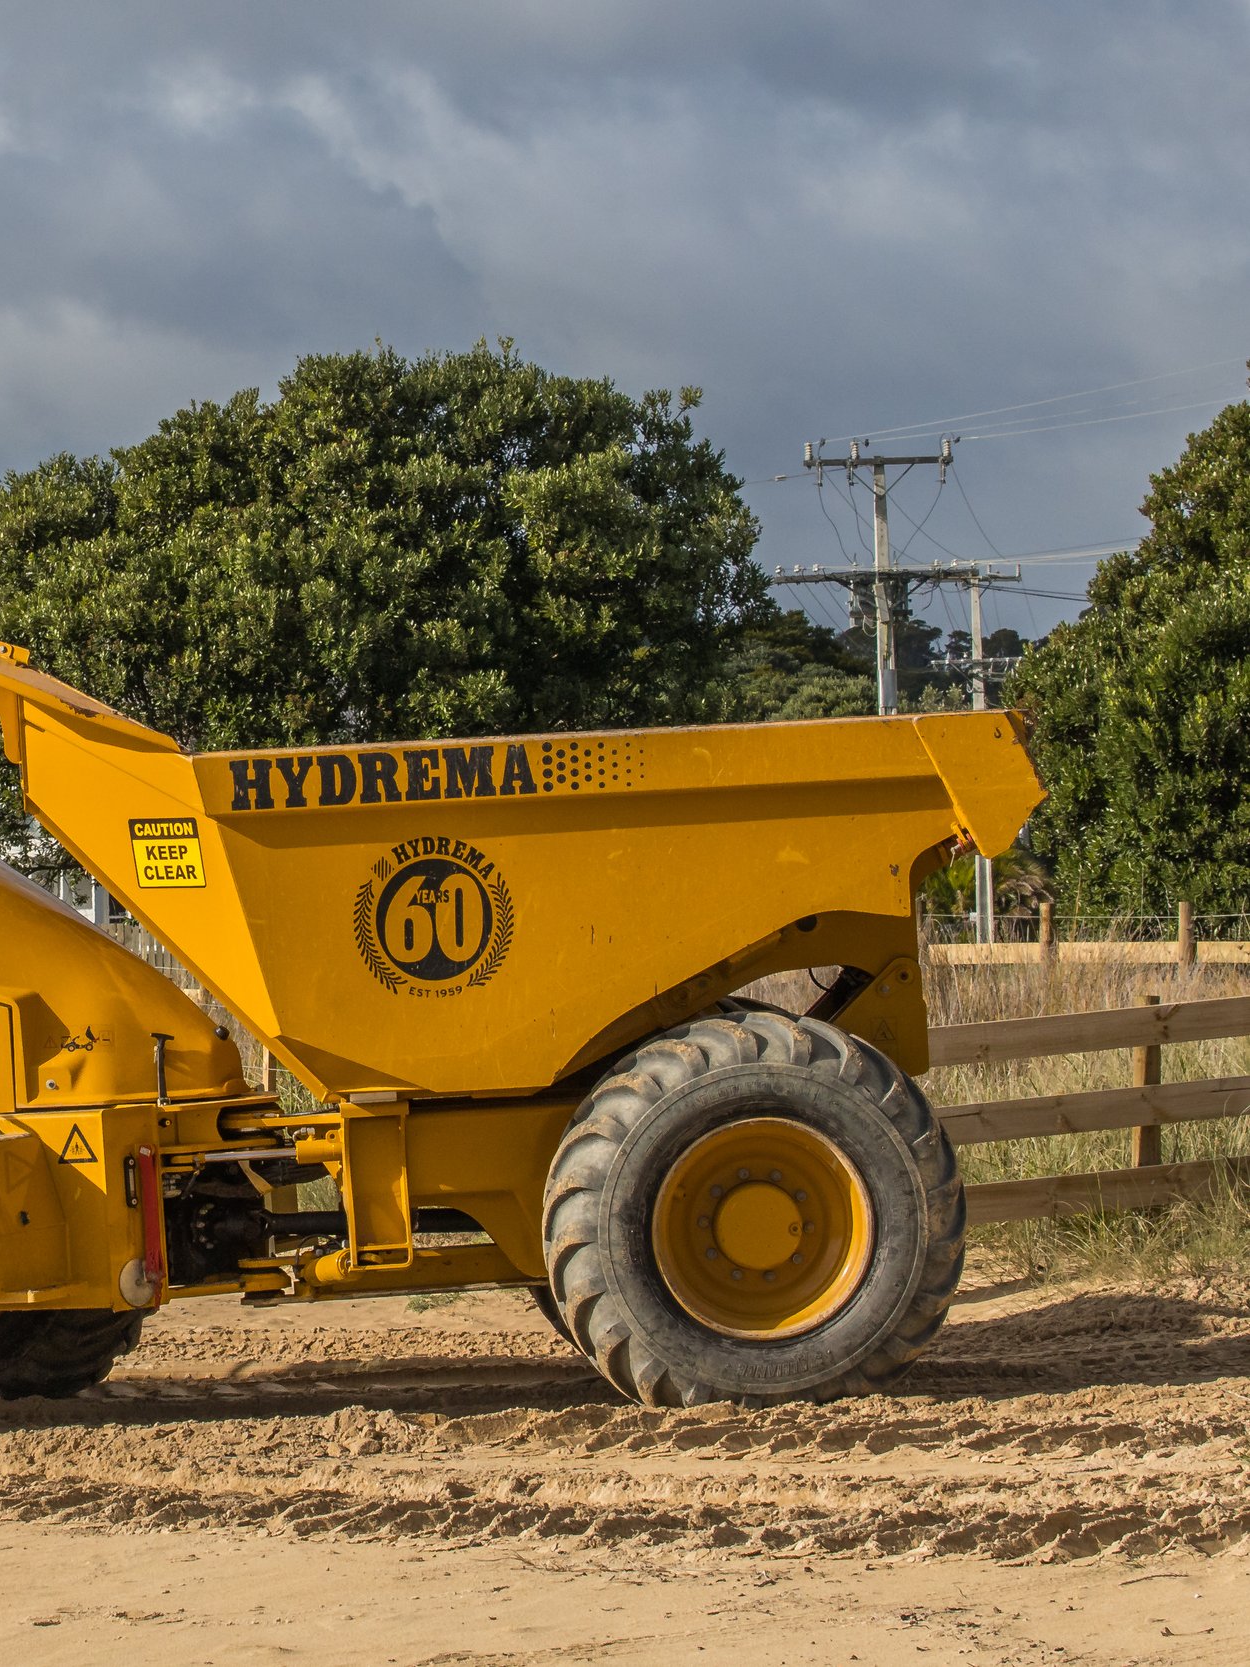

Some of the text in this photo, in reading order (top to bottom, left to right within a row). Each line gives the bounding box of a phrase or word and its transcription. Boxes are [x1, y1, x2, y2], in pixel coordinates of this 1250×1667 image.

[229, 744, 538, 811] HYDREMA
[134, 822, 194, 837] CAUTION
[145, 845, 188, 861] KEEP
[391, 836, 495, 880] HYDREMA
[143, 864, 198, 880] CLEAR
[416, 889, 450, 904] YEARS
[384, 873, 484, 963] 60
[408, 985, 463, 998] EST 1959
